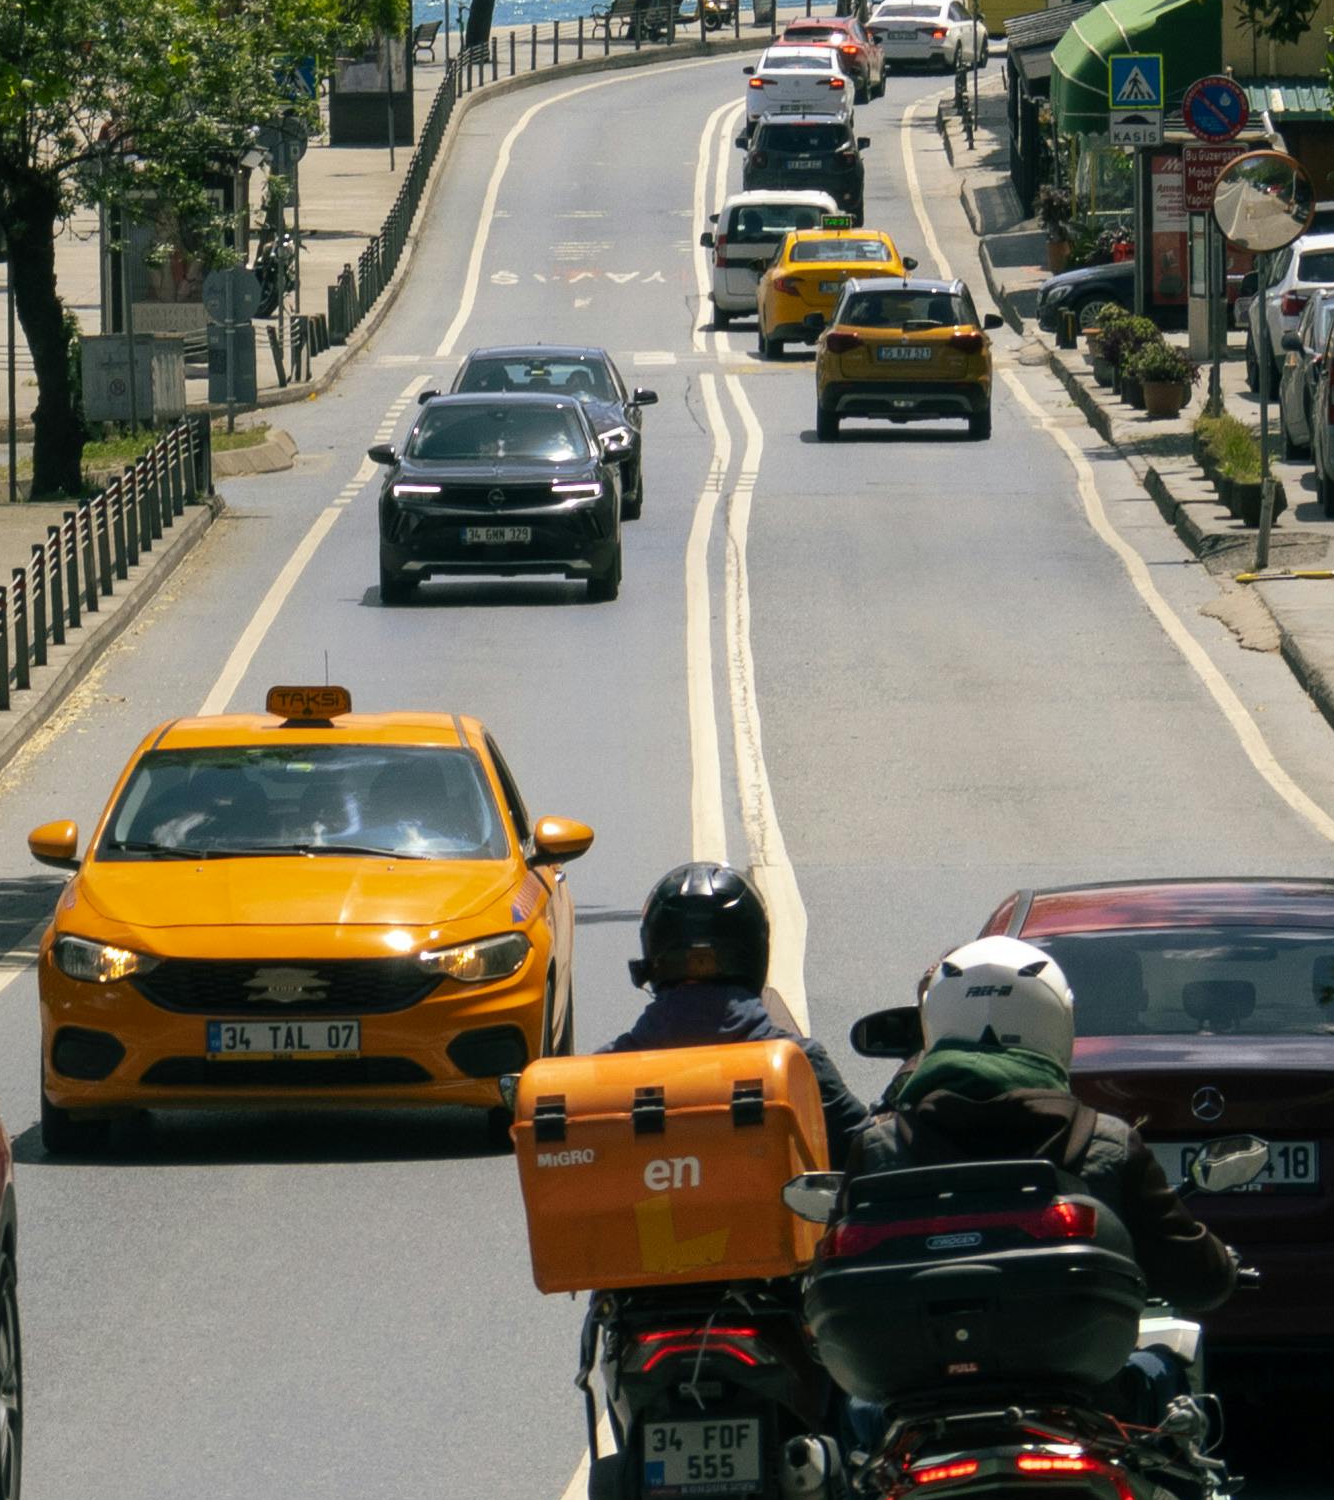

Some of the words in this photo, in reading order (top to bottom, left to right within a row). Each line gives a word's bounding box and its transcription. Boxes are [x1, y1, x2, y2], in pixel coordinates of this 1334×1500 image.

[224, 1026, 251, 1050] 34
[269, 1025, 310, 1050] TAL
[327, 1025, 354, 1049] 07
[643, 1155, 701, 1191] en
[652, 1427, 683, 1452] 34
[688, 1454, 734, 1480] 555
